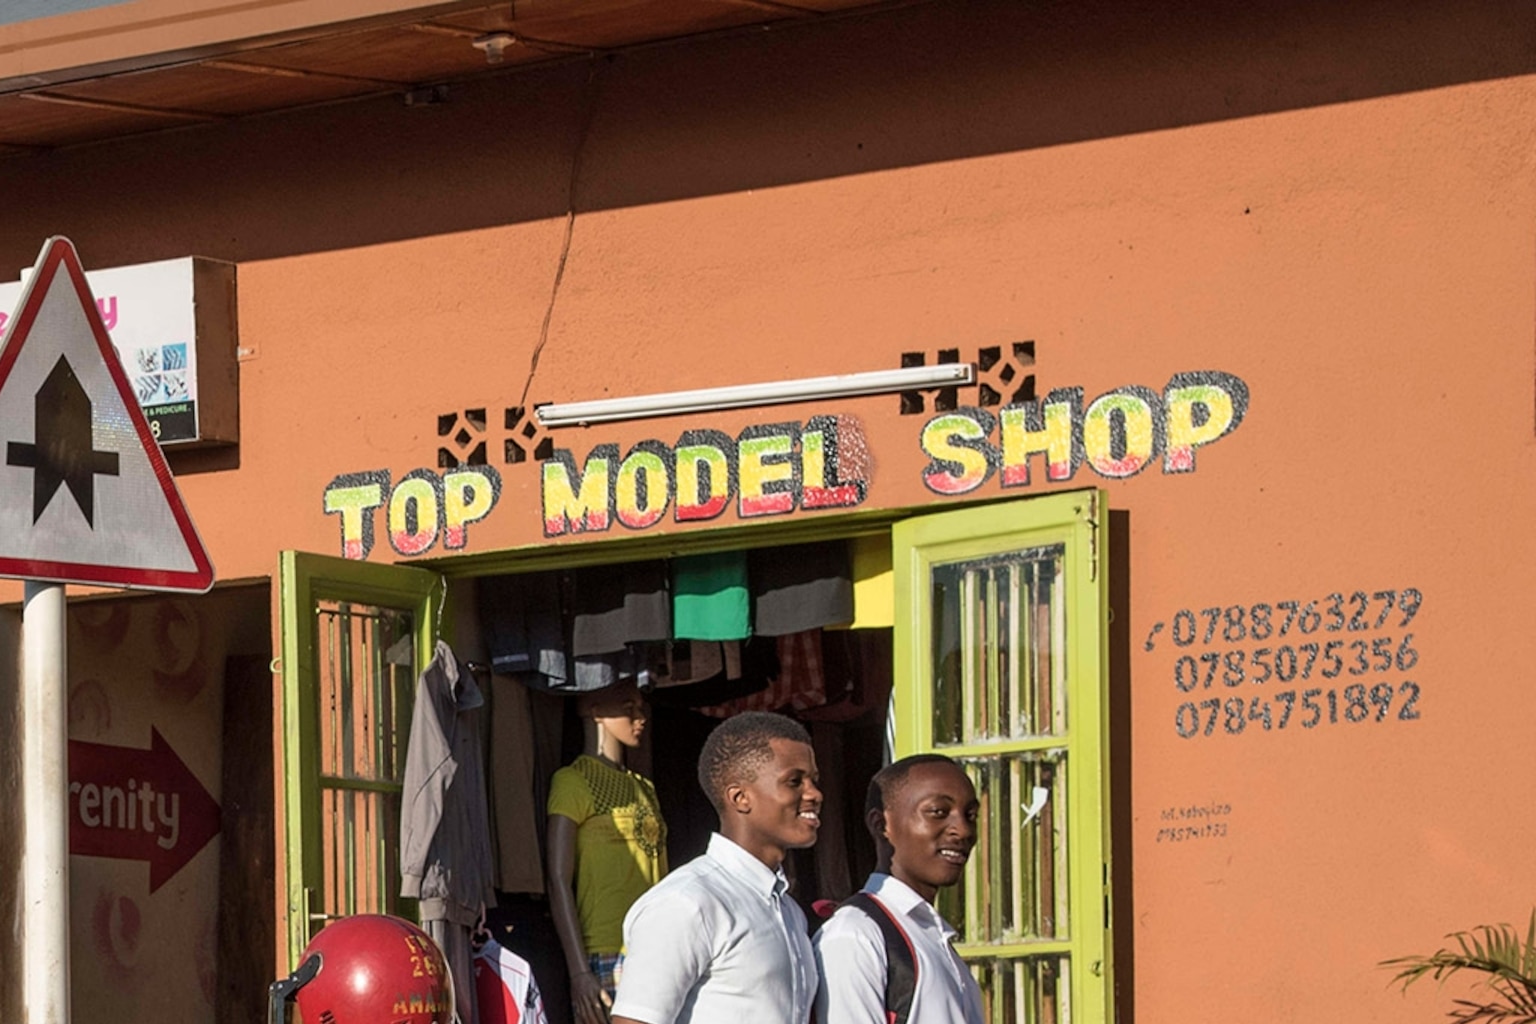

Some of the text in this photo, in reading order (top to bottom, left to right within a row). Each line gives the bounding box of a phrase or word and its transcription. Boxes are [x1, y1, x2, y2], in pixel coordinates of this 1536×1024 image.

[322, 369, 1250, 562] TOP MODEL SHOP
[1171, 587, 1423, 648] 0788763279
[1173, 632, 1419, 693] 0785075356
[1174, 680, 1421, 740] 0784751892
